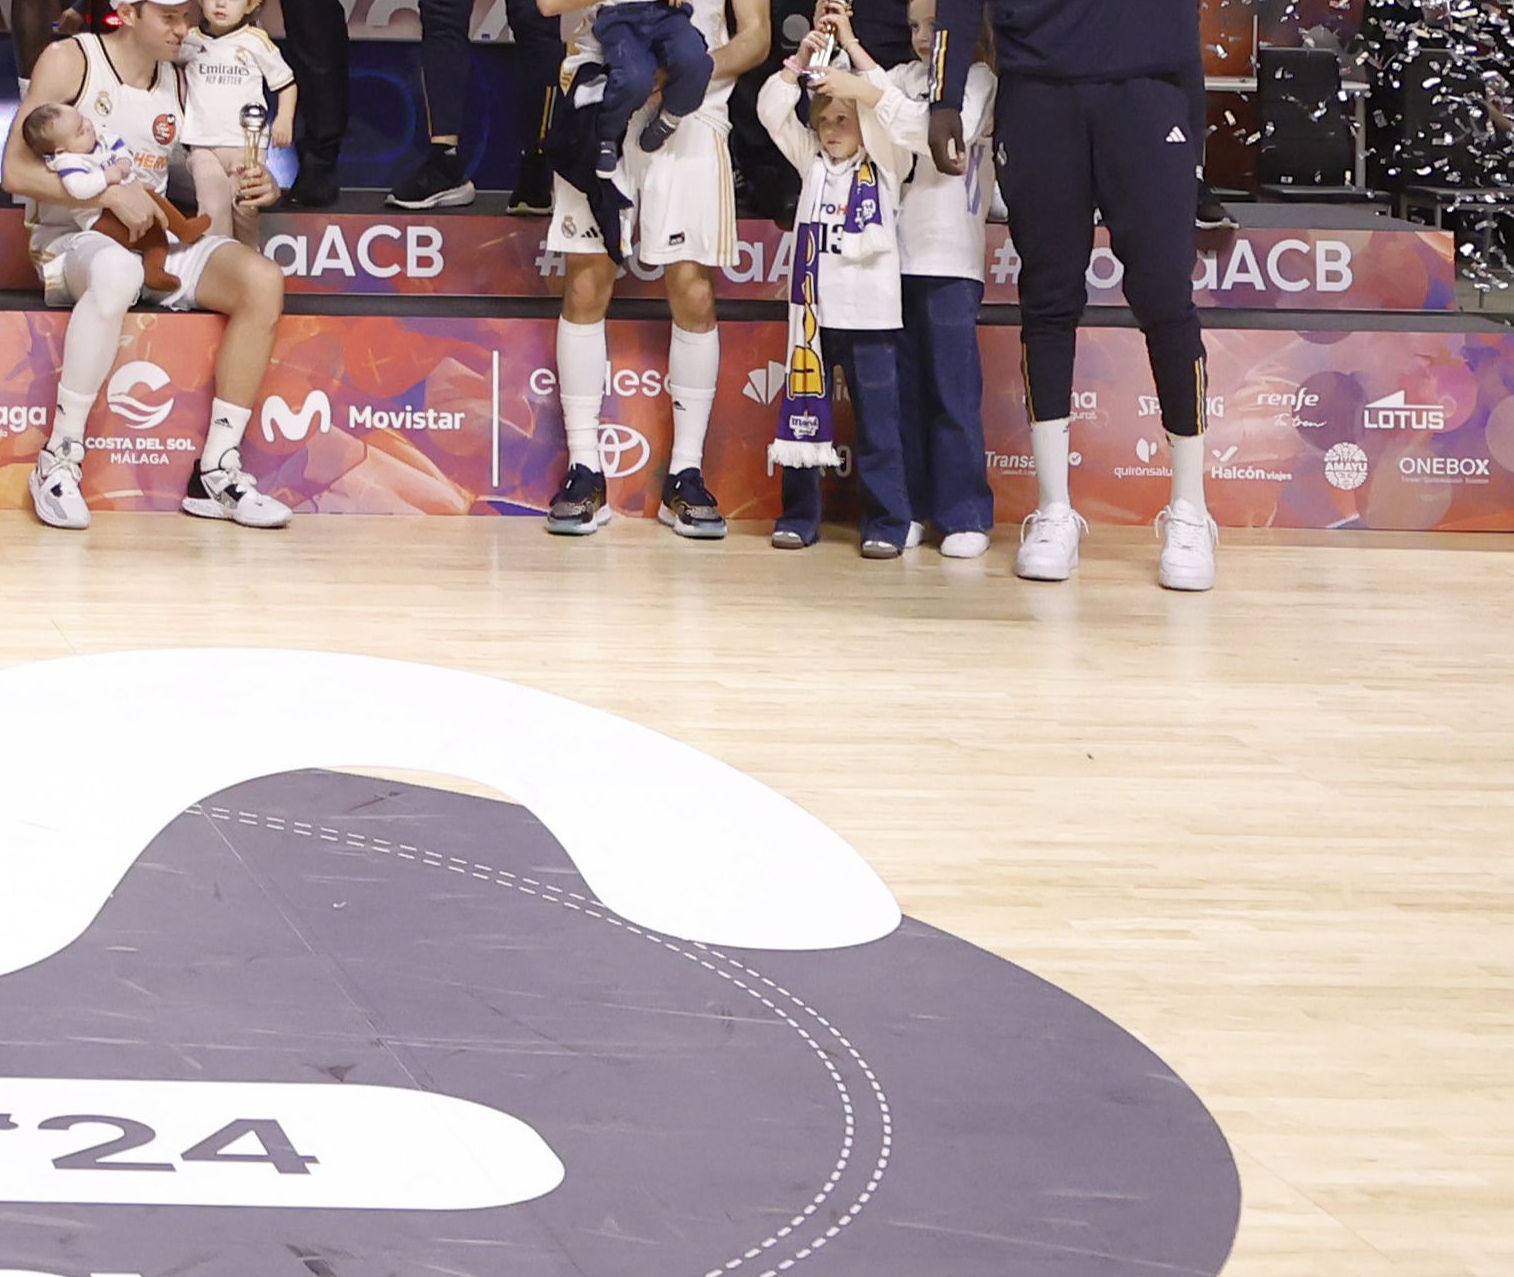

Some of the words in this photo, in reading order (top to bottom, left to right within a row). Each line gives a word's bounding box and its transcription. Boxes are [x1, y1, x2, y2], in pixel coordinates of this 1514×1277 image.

[199, 64, 250, 76] Emirates
[1257, 387, 1319, 411] renfe
[349, 404, 465, 430] Movistar
[1364, 410, 1445, 429] LOTUS
[85, 438, 132, 449] COSTA
[136, 438, 164, 450] DEL
[166, 438, 196, 450] SOL
[111, 450, 169, 464] MÁLAGA
[985, 451, 1036, 468] Transa
[1114, 465, 1172, 478] quirónsalu
[1211, 466, 1265, 480] Halcón
[1325, 462, 1367, 471] AMAYU
[1399, 457, 1490, 475] ONEBOX
